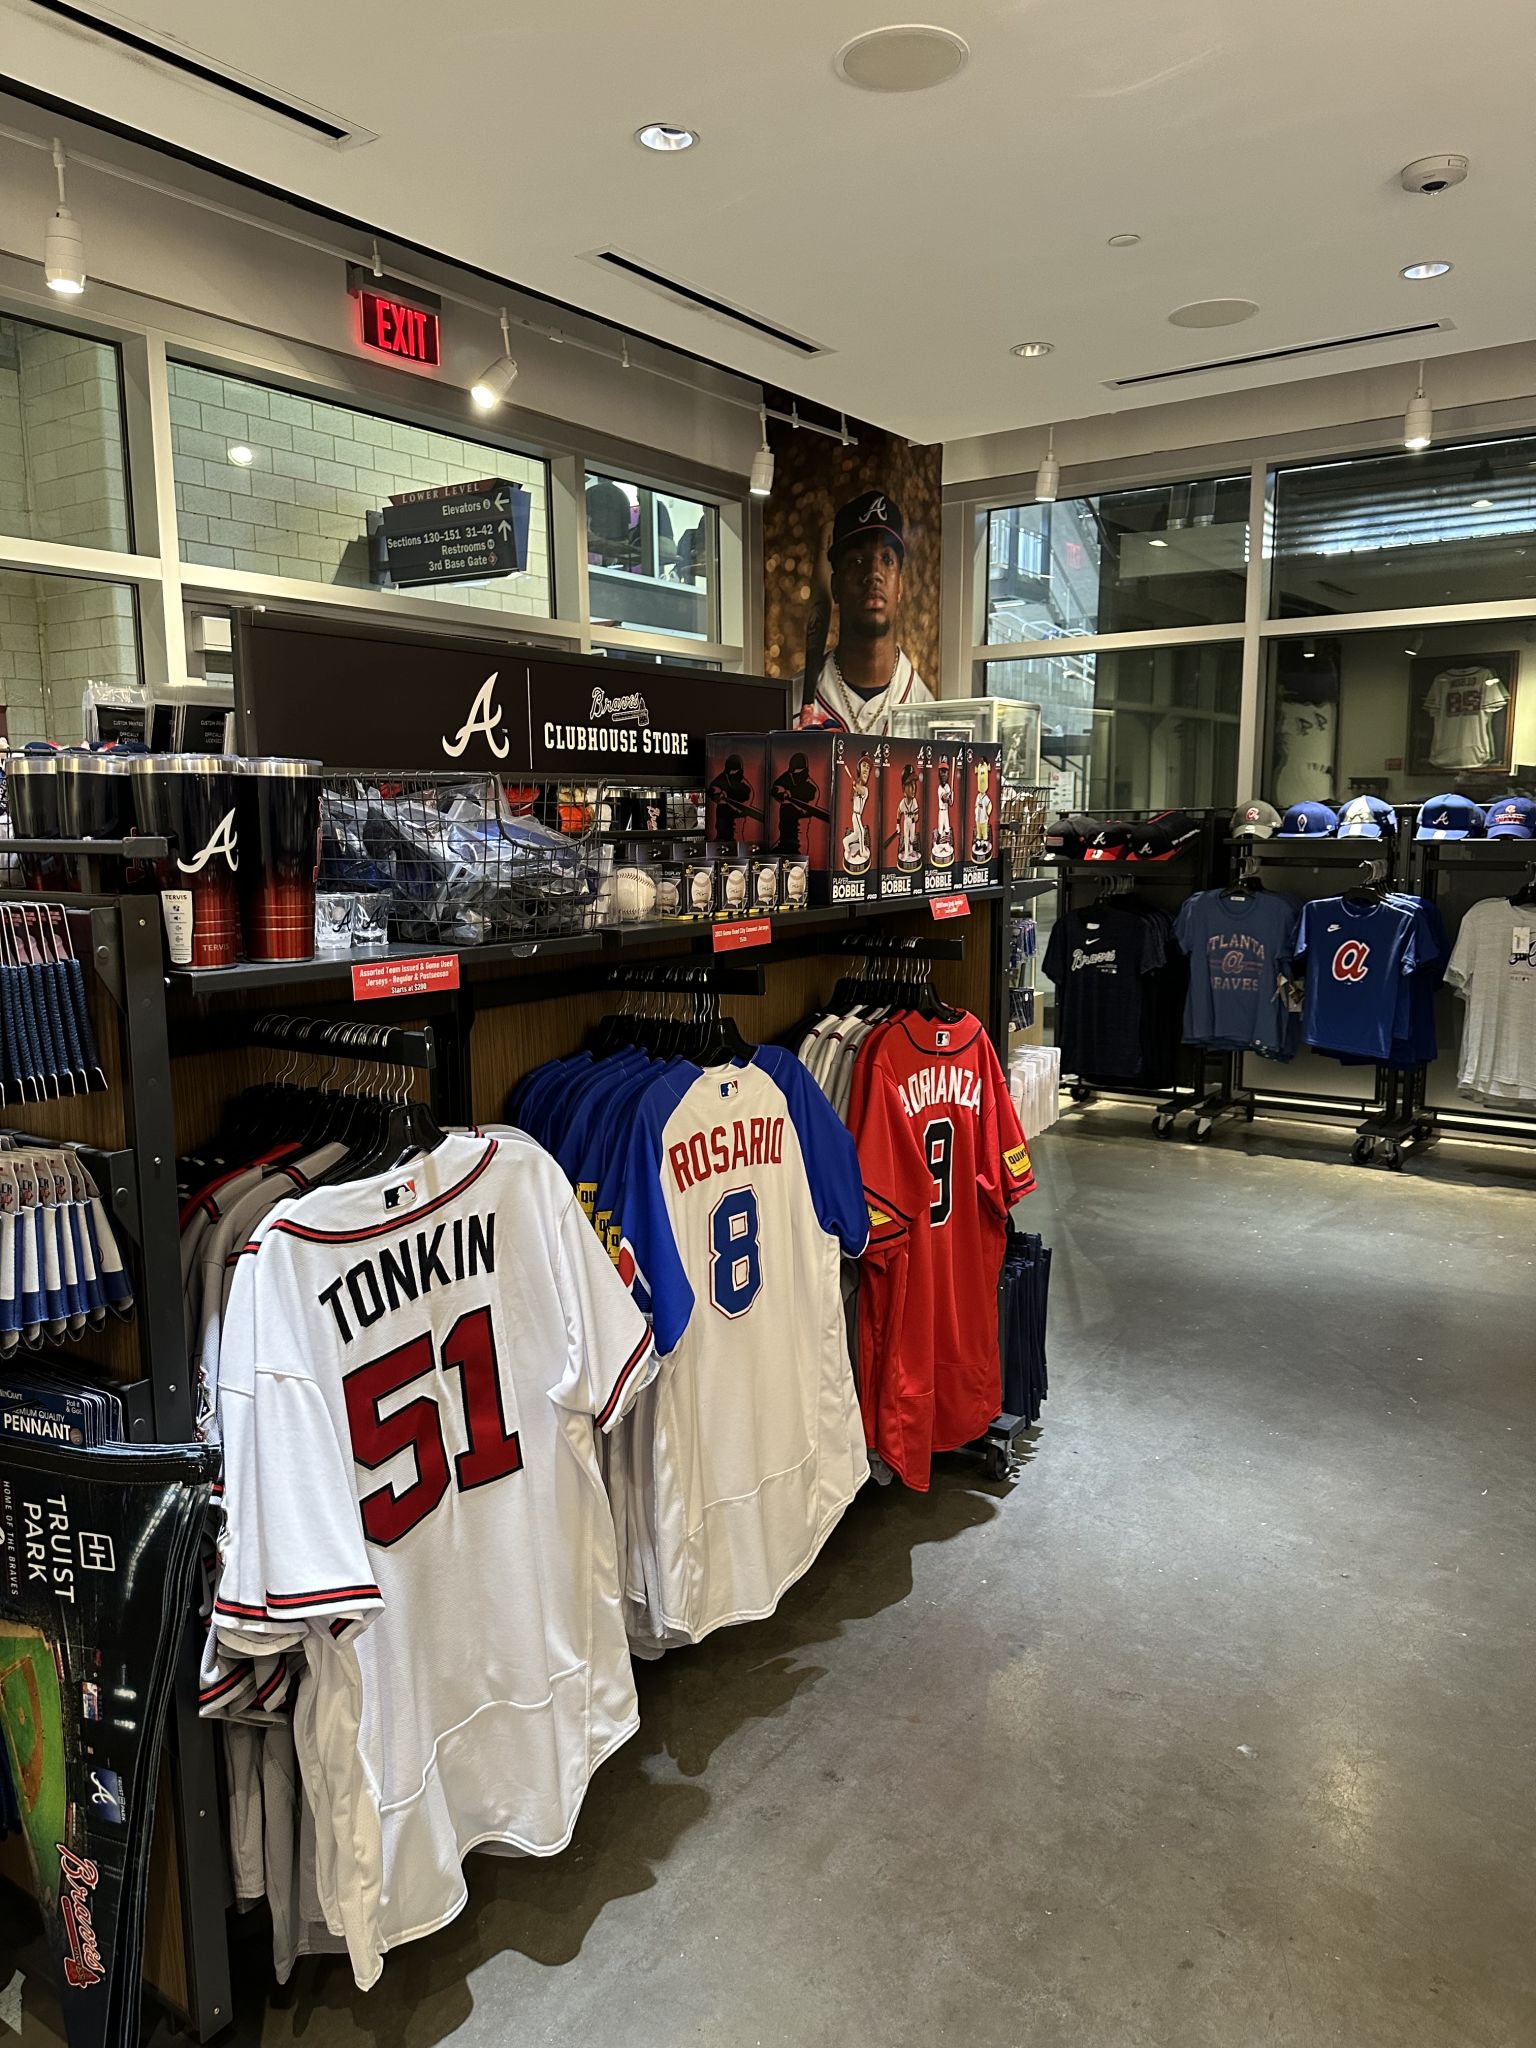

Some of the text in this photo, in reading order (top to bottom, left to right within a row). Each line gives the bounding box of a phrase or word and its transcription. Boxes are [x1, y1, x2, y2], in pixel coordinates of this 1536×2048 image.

[376, 298, 427, 360] EXIT
[402, 482, 480, 504] LOWER LEVEL
[442, 502, 482, 516] Elevators
[387, 536, 422, 549] Sections
[441, 542, 487, 556] Restrooms
[428, 555, 488, 572] 3rd Base Gate
[589, 686, 642, 720] Braves
[442, 671, 510, 759] A
[544, 722, 689, 755] CLUBHOUSE STORE
[177, 807, 239, 874] A
[832, 877, 848, 885] PLAYER
[882, 879, 912, 894] BOBBLE
[925, 875, 952, 889] BOBBLE
[963, 871, 989, 884] BOBBLE
[832, 884, 865, 898] BOBBLE
[1206, 933, 1265, 960] TLANTA
[359, 966, 385, 977] Assorted
[386, 966, 400, 974] Team
[401, 962, 419, 971] Issued
[425, 961, 440, 969] Game
[440, 959, 454, 968] Used
[1071, 948, 1116, 971] Braves
[366, 978, 388, 987] Jerseys
[392, 975, 413, 985] Regular
[391, 986, 407, 994] Starts
[1211, 976, 1259, 991] RAVES
[897, 1065, 982, 1118] ADRIANZA
[668, 1117, 785, 1193] ROSARIO
[923, 1117, 954, 1228] 9
[708, 1183, 763, 1320] 8
[317, 1212, 496, 1345] TONKIN
[65, 1405, 70, 1413] &
[66, 1399, 76, 1407] Roll
[3, 1412, 71, 1441] PENNANT
[38, 1410, 65, 1423] QUALITY
[342, 1304, 524, 1548] 51
[3, 1480, 19, 1596] HOME OF THE BRAVES
[23, 1502, 48, 1583] PARK
[47, 1494, 74, 1603] TRUIST
[56, 1843, 105, 1974] Braves
